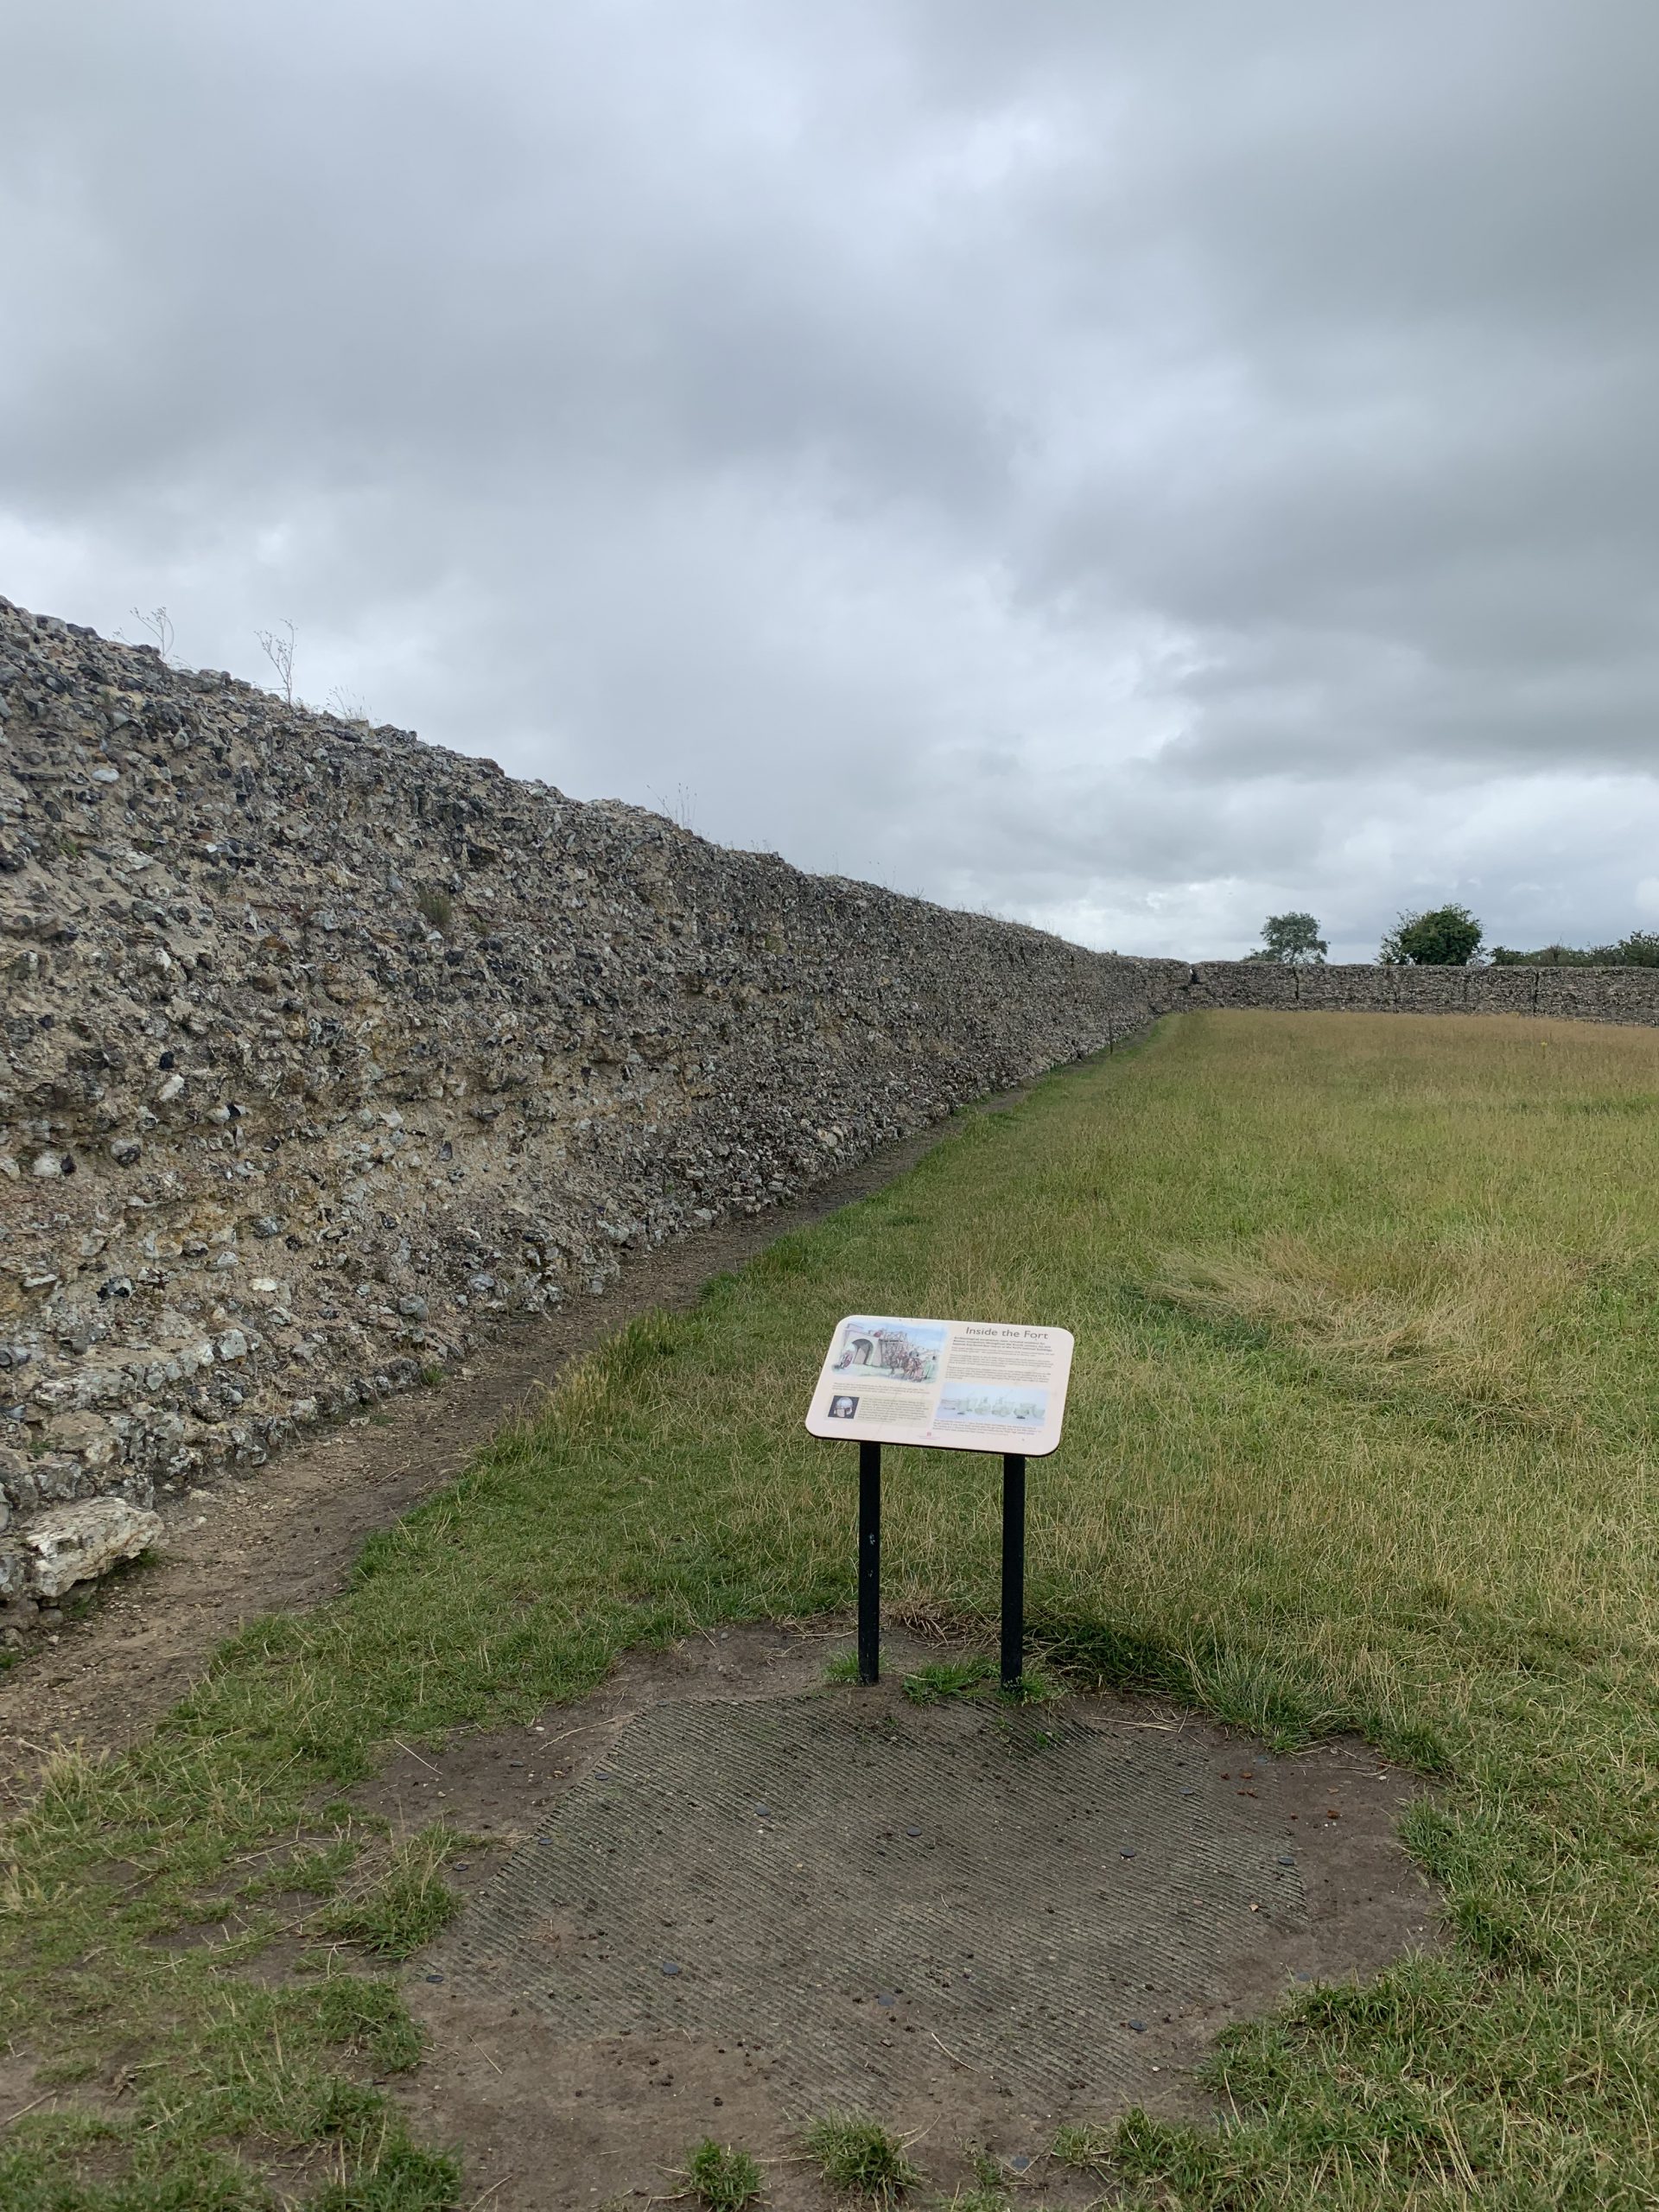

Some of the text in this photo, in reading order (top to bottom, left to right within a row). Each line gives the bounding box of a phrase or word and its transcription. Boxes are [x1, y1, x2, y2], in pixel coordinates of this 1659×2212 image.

[966, 1326, 1049, 1339] Inside the Fort
